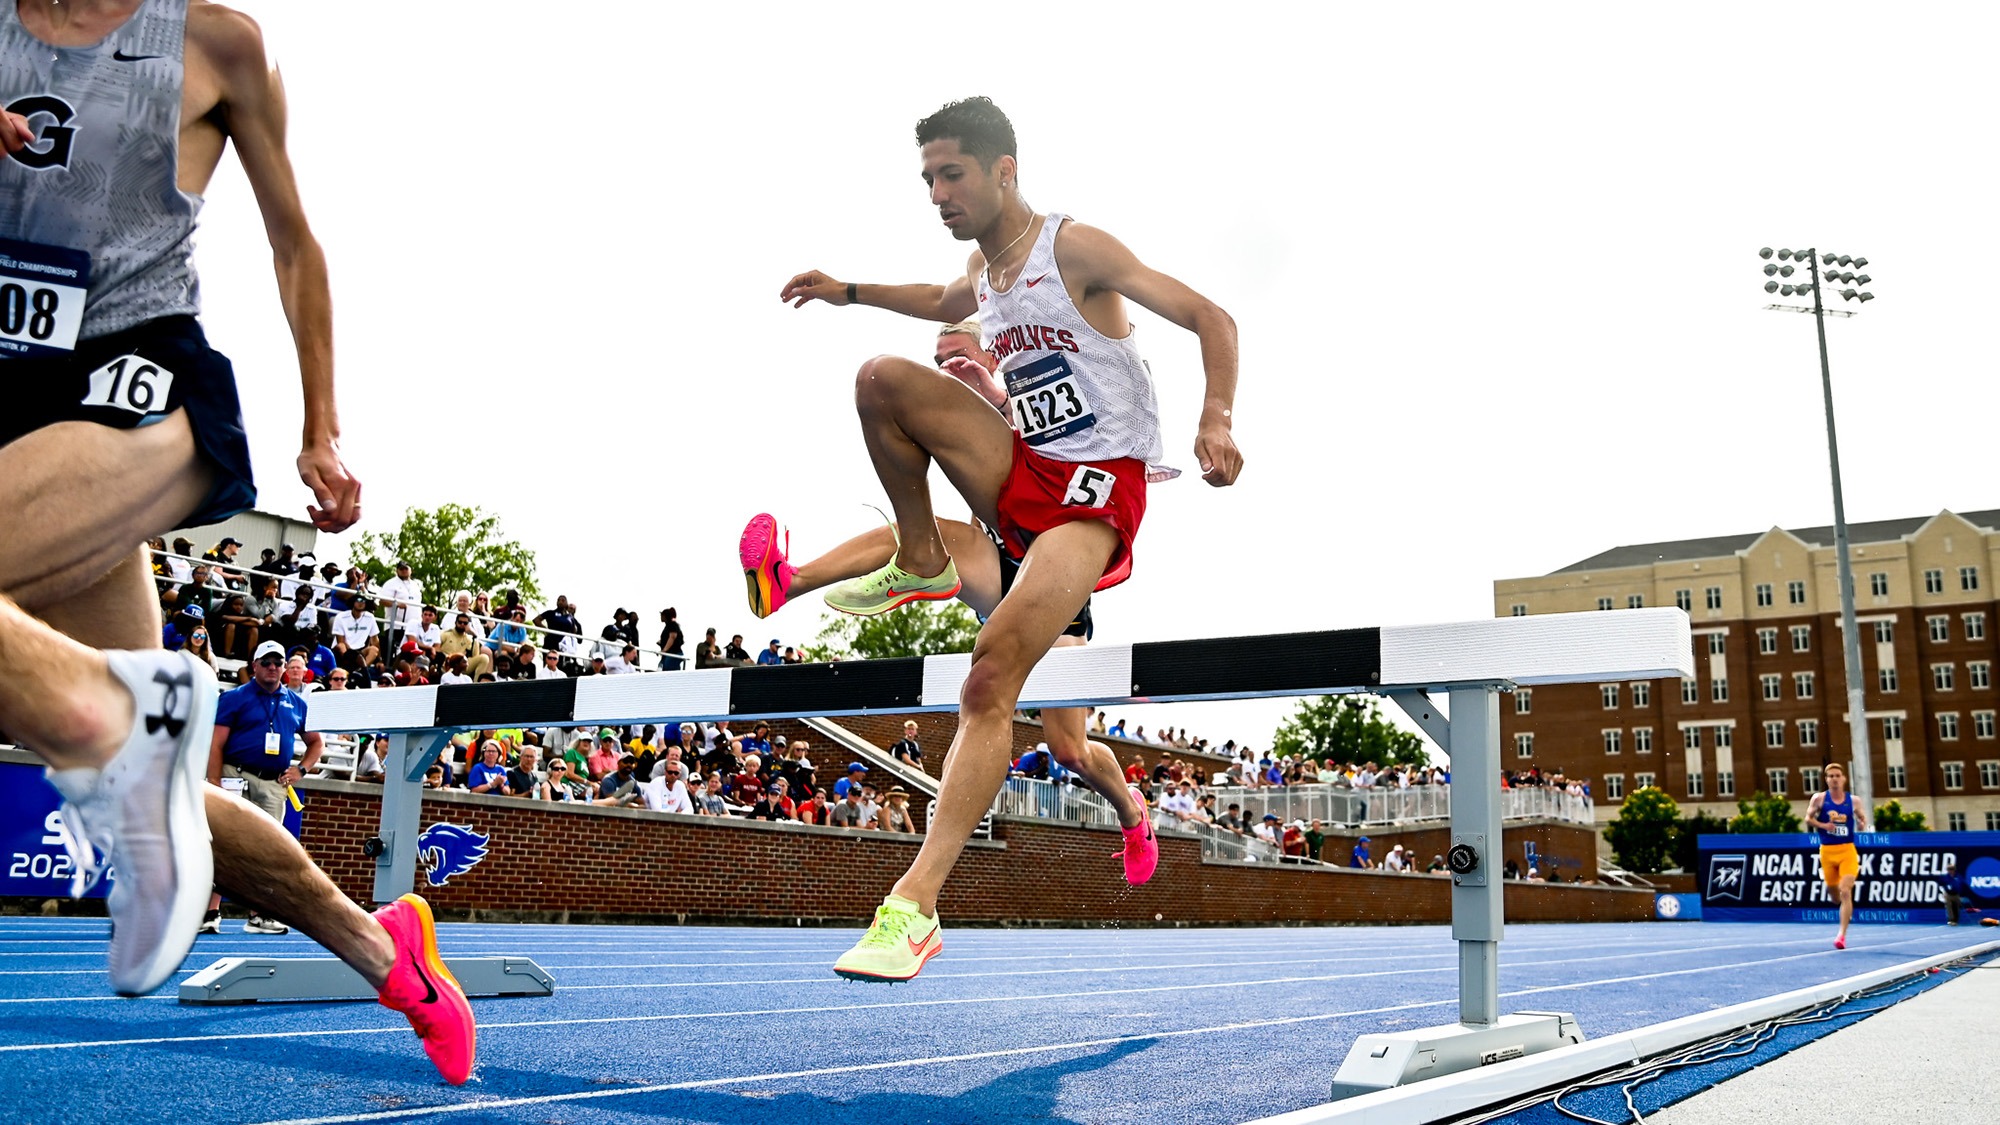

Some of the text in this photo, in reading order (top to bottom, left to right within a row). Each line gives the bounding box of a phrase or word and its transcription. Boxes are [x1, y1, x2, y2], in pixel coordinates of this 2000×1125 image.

[4, 93, 83, 172] G
[18, 261, 78, 278] CHAMPIONSHIPS
[987, 324, 1079, 364] EAWOLVES
[107, 358, 159, 411] 16
[1016, 382, 1083, 434] 1523
[1069, 469, 1106, 507] 5
[1858, 834, 1890, 844] TO THE
[1752, 853, 1804, 876] NCAA
[1879, 853, 1894, 876] &
[1900, 853, 1957, 876] FIELD
[1760, 880, 1806, 902] EAST
[1810, 880, 1865, 902] FIT
[1970, 876, 2000, 888] NCA
[1859, 910, 1908, 921] KENTUCKY
